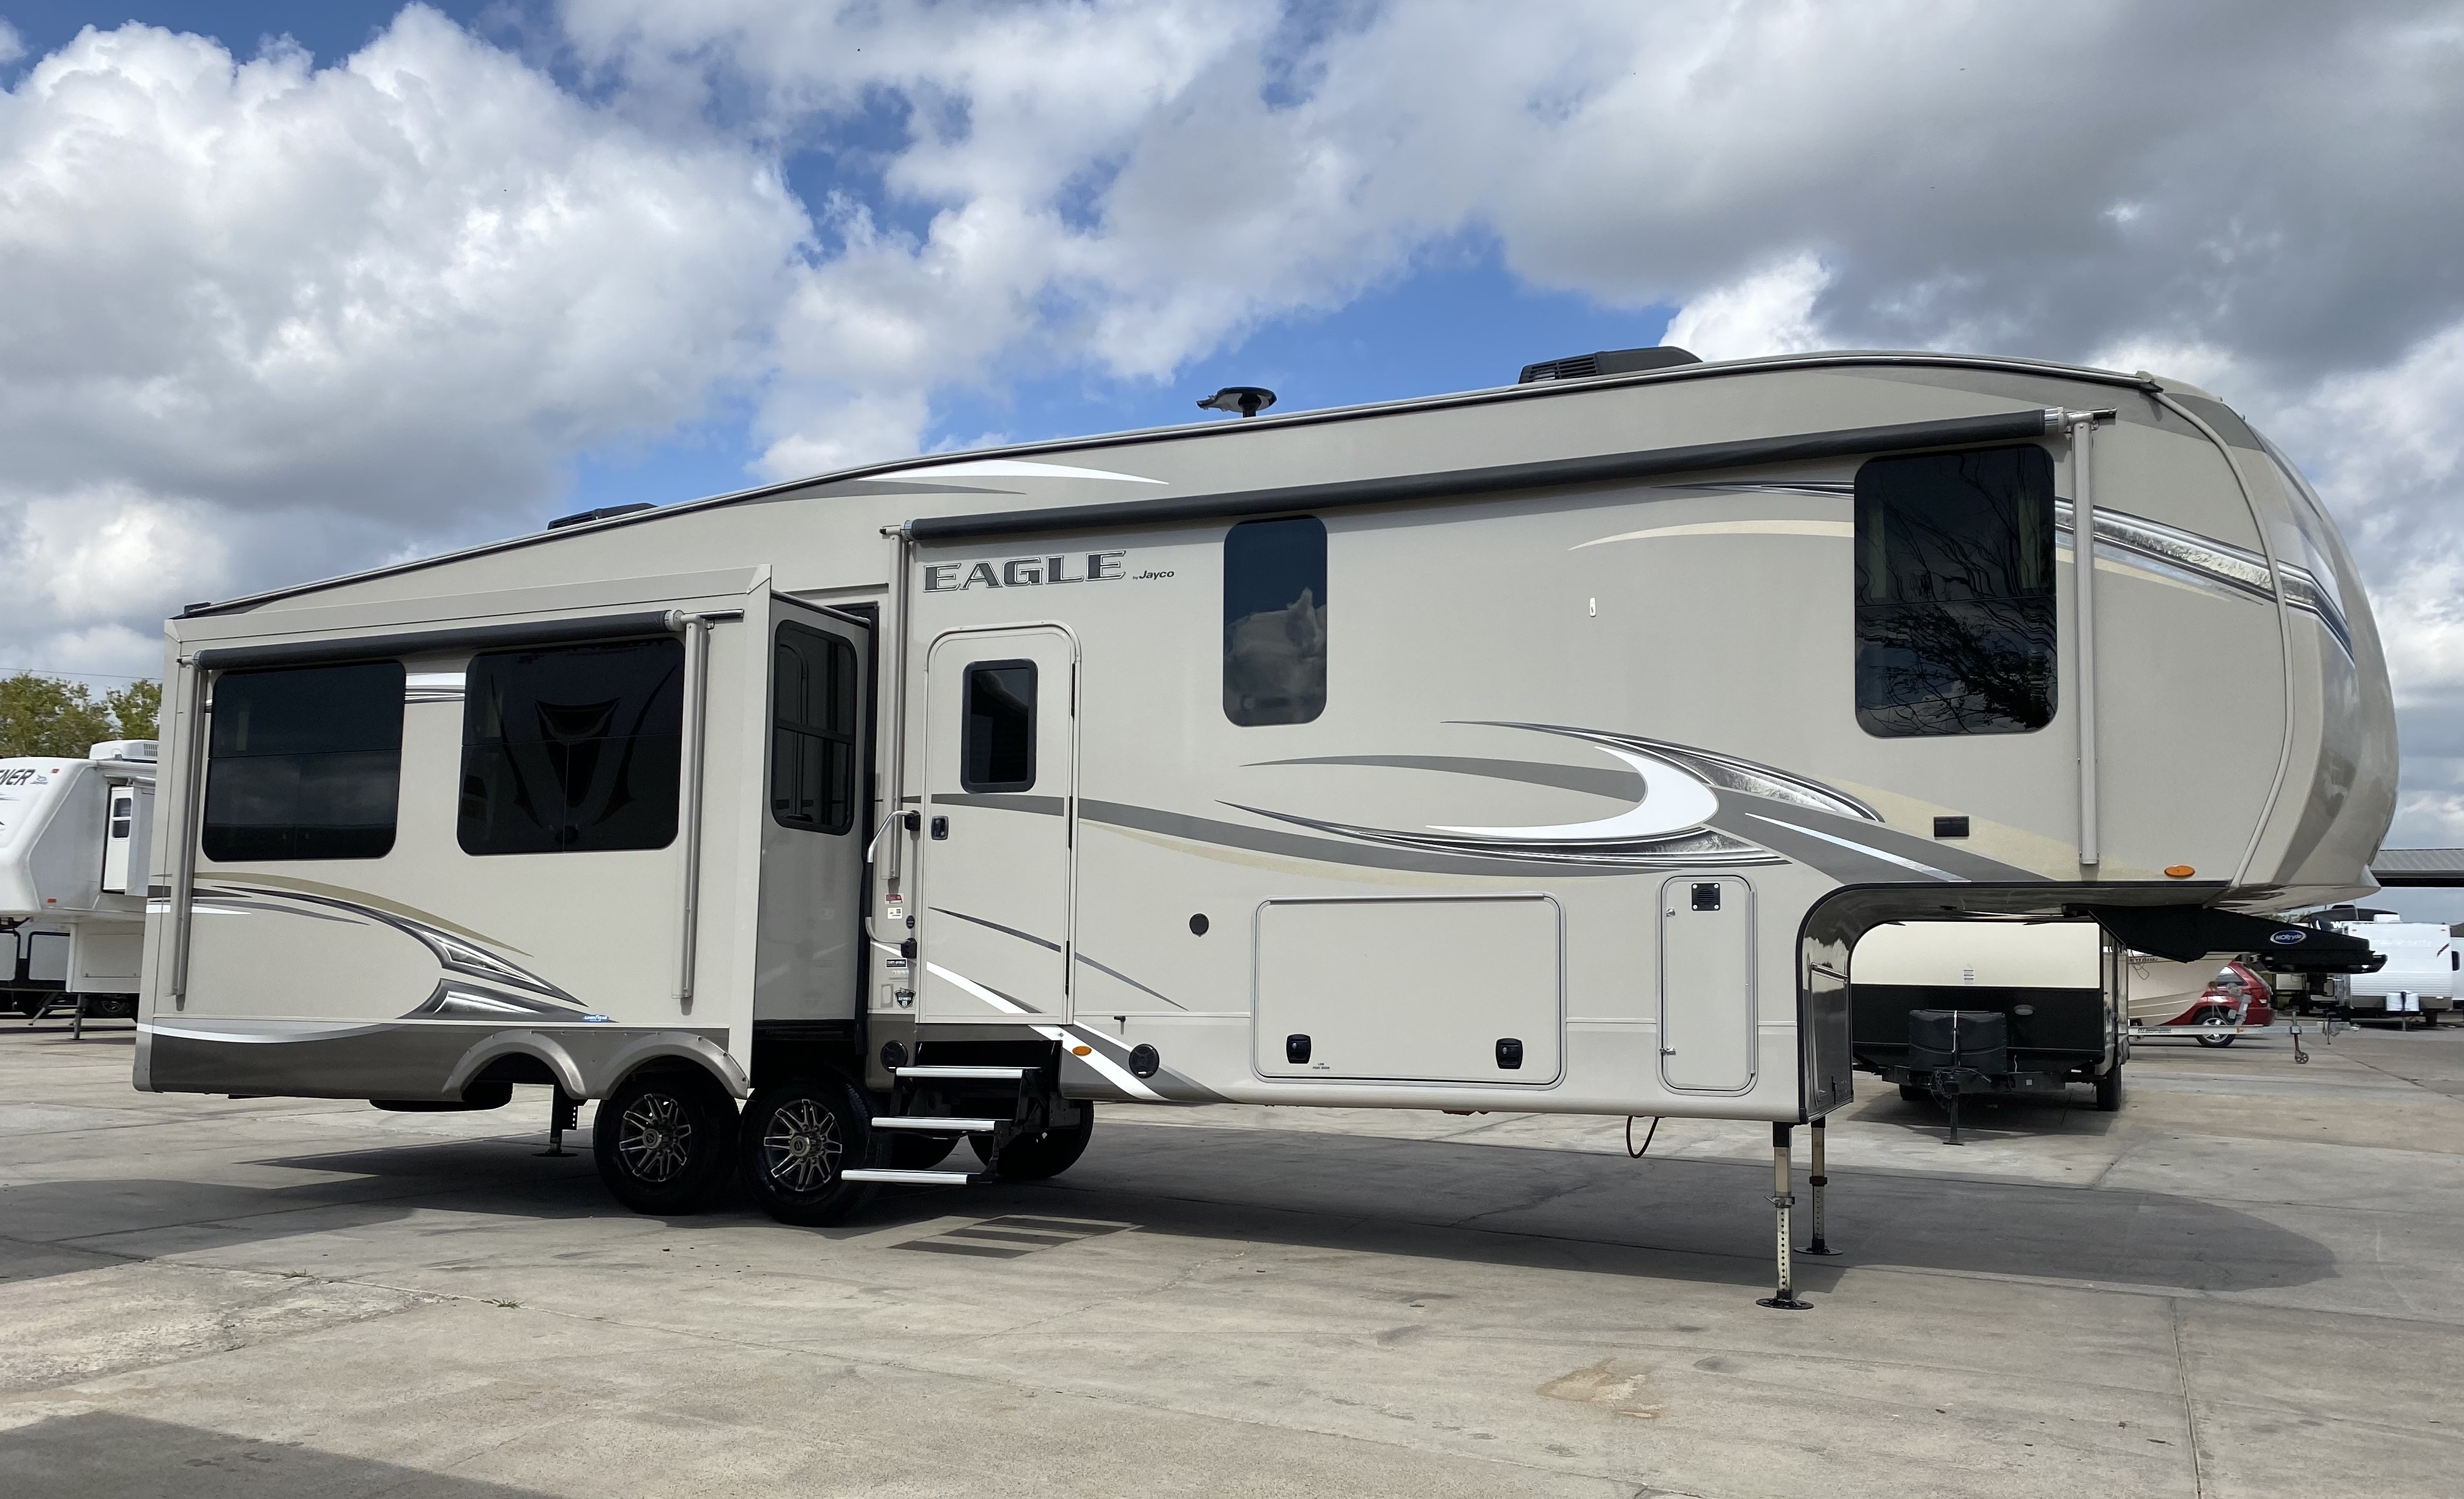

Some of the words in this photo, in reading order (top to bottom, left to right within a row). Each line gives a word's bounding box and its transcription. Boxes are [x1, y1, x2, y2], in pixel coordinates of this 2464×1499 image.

[923, 551, 1127, 593] EAGLE
[1139, 570, 1174, 580] Jayco
[0, 768, 35, 785] NER
